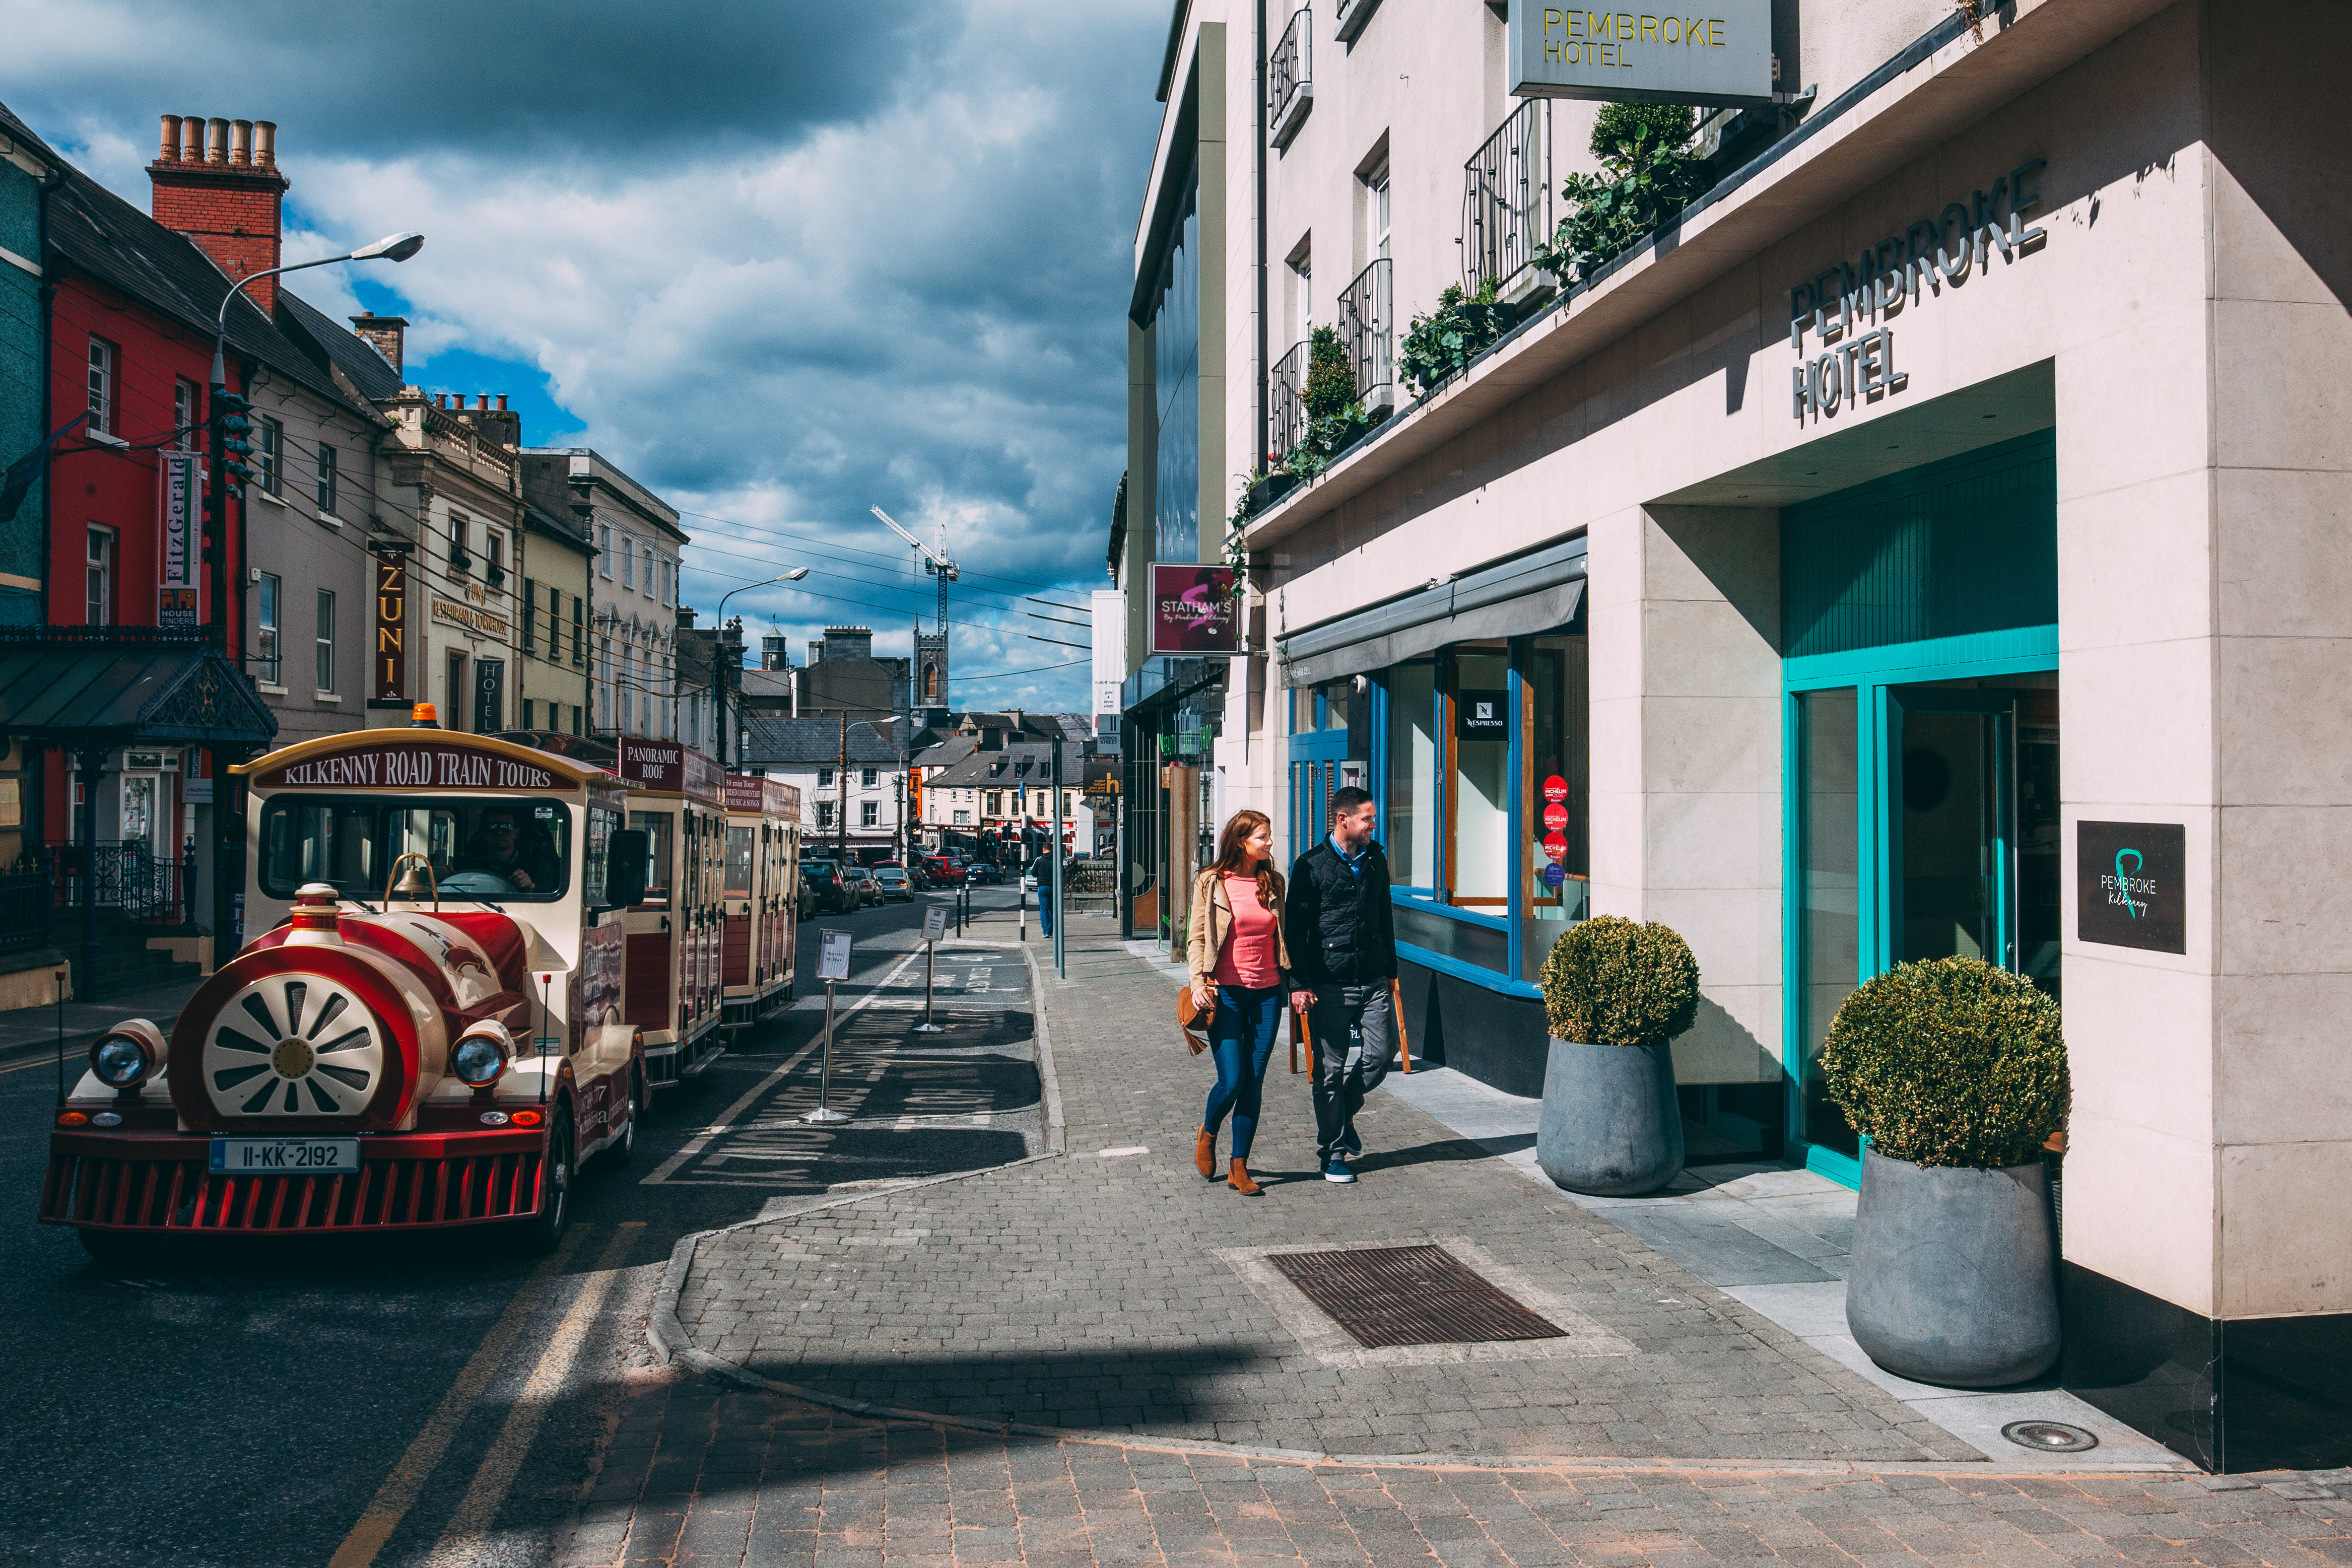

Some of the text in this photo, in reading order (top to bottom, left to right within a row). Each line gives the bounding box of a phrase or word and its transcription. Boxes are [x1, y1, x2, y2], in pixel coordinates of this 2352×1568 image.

[1544, 9, 1725, 47] PEMBROKE
[1544, 40, 1633, 67] HOTEL
[1791, 158, 2047, 349] PEMBROKE
[1792, 326, 1906, 419] HOTEL
[167, 458, 185, 583] FitzGerald
[1162, 601, 1232, 613] STATHAM'S
[378, 567, 403, 684] ZUNI
[484, 665, 495, 730] HOTEL
[1465, 718, 1503, 728] NESPRESSO
[627, 746, 679, 764] PANORAMIC
[285, 752, 552, 787] KILKENNY ROAD TRAIN TOURS
[642, 764, 664, 779] ROOF
[743, 780, 755, 788] Tour
[730, 798, 743, 806] MUSIC
[747, 799, 760, 807] SONGS
[2101, 875, 2156, 894] PEMBROKE
[2109, 891, 2148, 917] Kilkenny
[243, 1146, 338, 1167] 11-KK-2192
